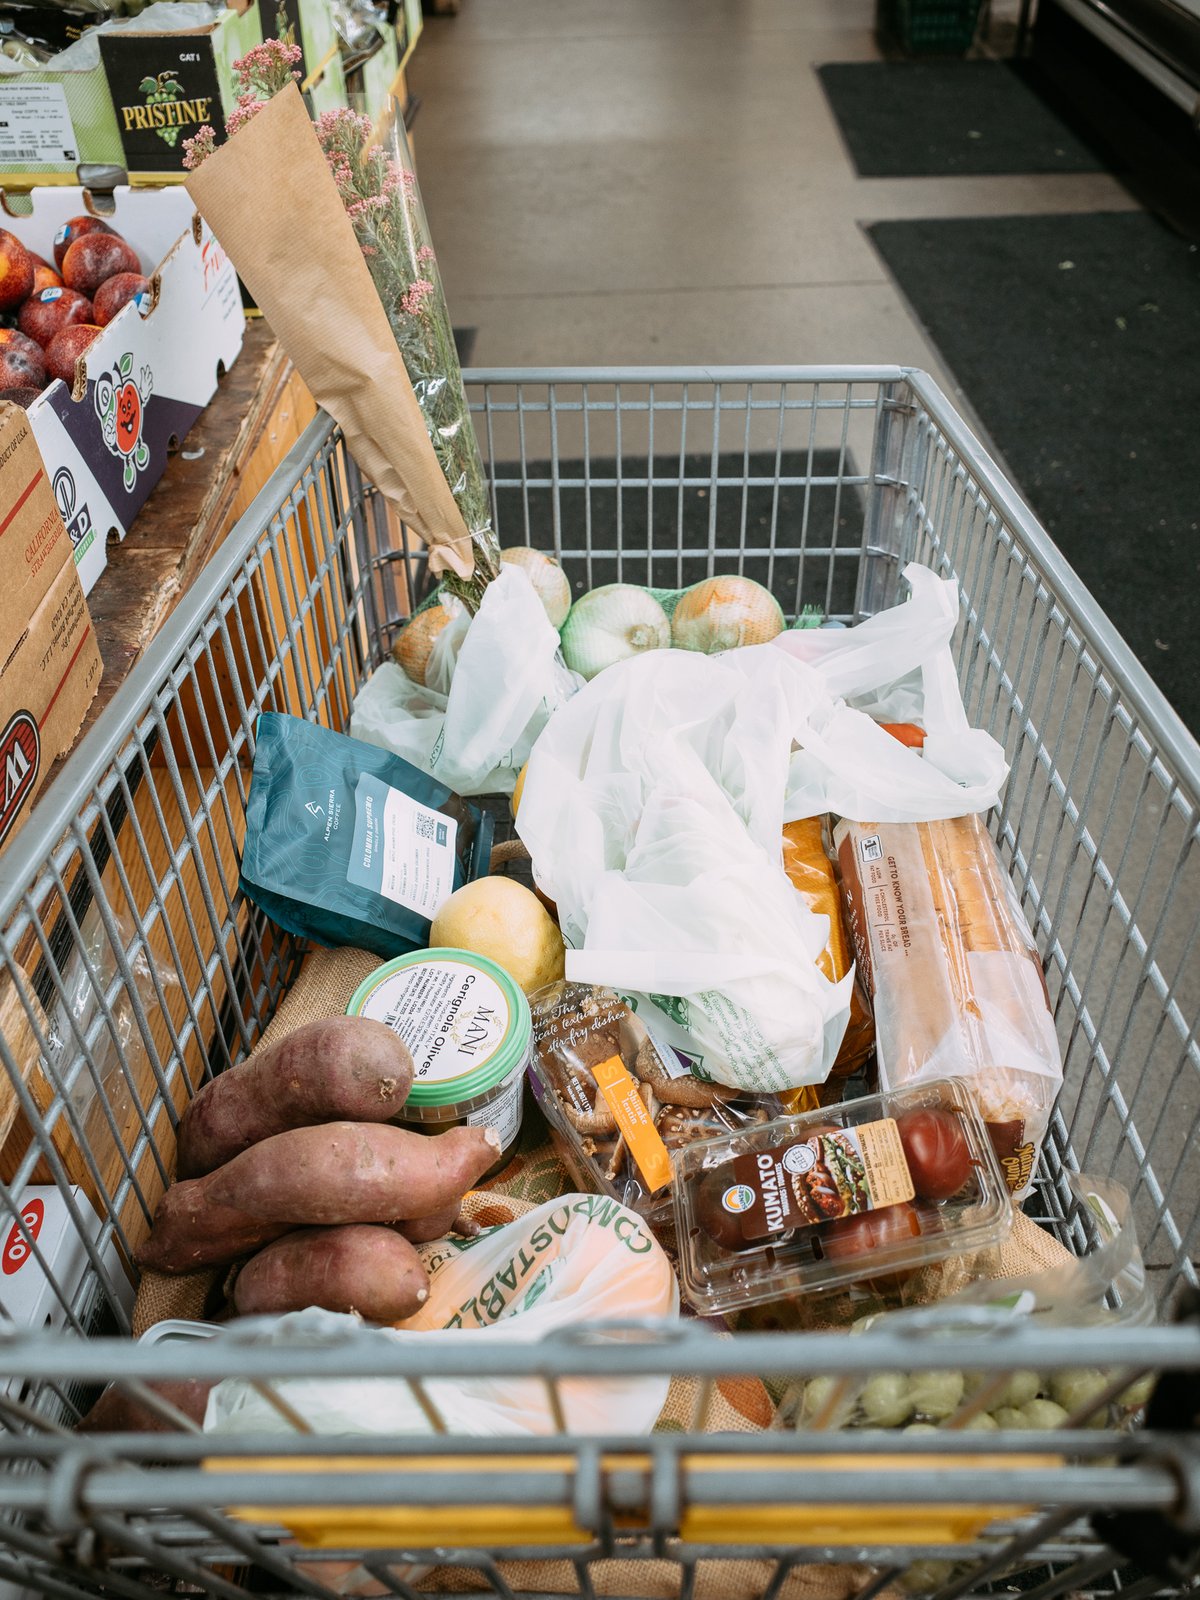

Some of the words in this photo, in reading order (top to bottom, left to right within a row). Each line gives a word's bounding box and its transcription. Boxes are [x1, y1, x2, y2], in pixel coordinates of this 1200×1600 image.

[179, 53, 195, 62] CAT
[121, 98, 211, 131] PRISTINE
[24, 506, 58, 564] CALIFORNIA
[30, 519, 65, 580] STRAWBERRIES
[328, 789, 336, 815] SIERRA
[366, 796, 374, 829] SUPREMO
[333, 803, 342, 830] COFFEE
[324, 817, 333, 842] ALPEN
[362, 831, 373, 868] COLOMBIA
[886, 856, 895, 869] GET
[889, 870, 898, 879] TO
[891, 880, 902, 903] KNOW
[879, 892, 889, 922] CHOLESTEROL
[896, 904, 906, 924] YOUR
[883, 928, 891, 943] TRANS
[899, 926, 911, 948] BREAD
[413, 975, 423, 988] BEFORE
[426, 967, 435, 978] LOT
[438, 973, 476, 1034] Cerignola
[424, 1013, 435, 1029] green
[457, 1005, 495, 1056] MANI
[422, 1029, 435, 1049] ITALY
[548, 1022, 590, 1055] stir-fry
[418, 1035, 446, 1077] Olives
[622, 1097, 638, 1126] lentin
[857, 1132, 868, 1152] TOMATO
[862, 1152, 872, 1169] BROWN
[1003, 1157, 1019, 1187] Own
[866, 1169, 876, 1186] UNIQUE
[737, 1185, 747, 1210] SUNSET
[756, 1152, 784, 1231] KUMATO
[870, 1186, 879, 1202] SIMPLY
[8, 1212, 38, 1261] OXO
